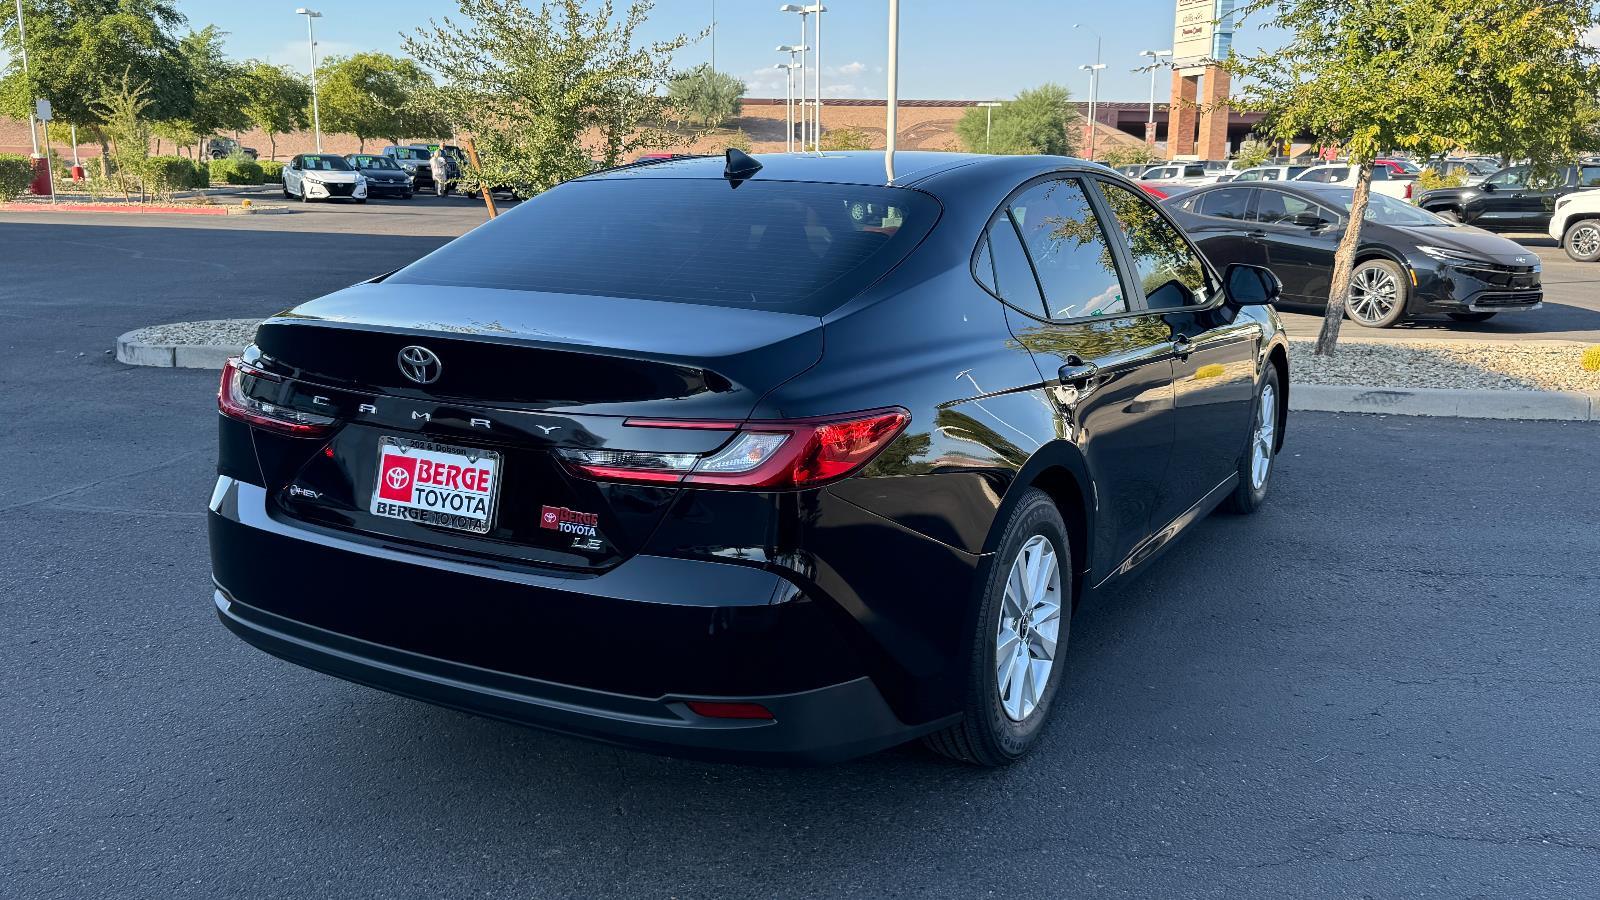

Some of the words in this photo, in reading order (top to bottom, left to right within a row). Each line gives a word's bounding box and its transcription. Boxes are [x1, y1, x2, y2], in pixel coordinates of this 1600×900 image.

[313, 395, 562, 435] CAMRY
[410, 440, 425, 449] 202
[427, 441, 433, 451] &
[436, 444, 467, 456] Dobson
[417, 458, 491, 493] BERGE
[415, 487, 487, 516] TOYOTA
[376, 501, 429, 520] BERGE
[434, 512, 486, 529] TOYOTA
[560, 506, 598, 528] BERGE
[559, 522, 597, 537] TOYOTA
[571, 537, 603, 551] LE
